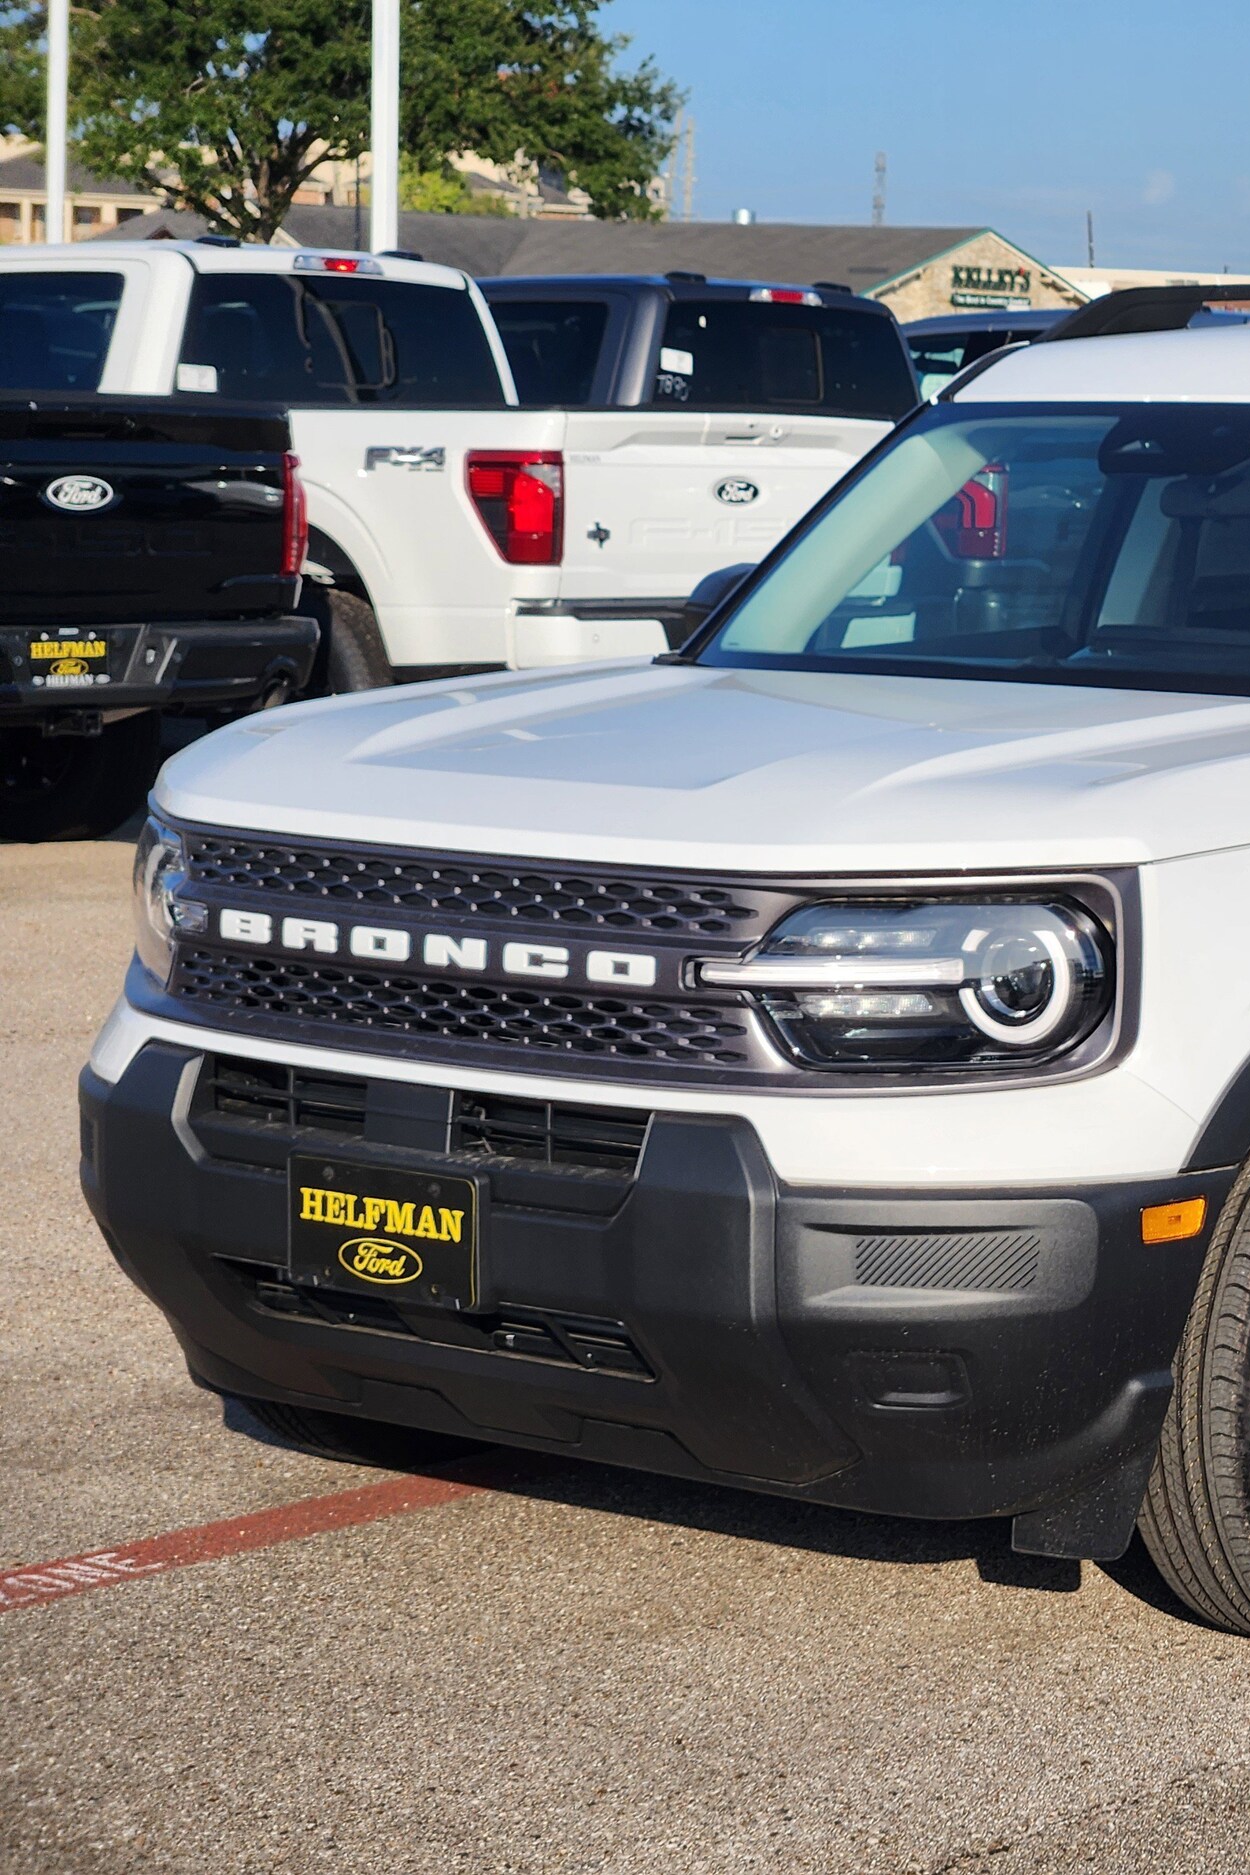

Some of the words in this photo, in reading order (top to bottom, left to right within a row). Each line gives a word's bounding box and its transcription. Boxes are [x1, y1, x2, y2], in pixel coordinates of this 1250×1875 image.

[57, 479, 103, 504] Ford
[30, 641, 106, 659] HELFMAN
[219, 907, 657, 987] BRONCO
[299, 1186, 465, 1243] HELFMAN
[353, 1242, 407, 1277] Ford
